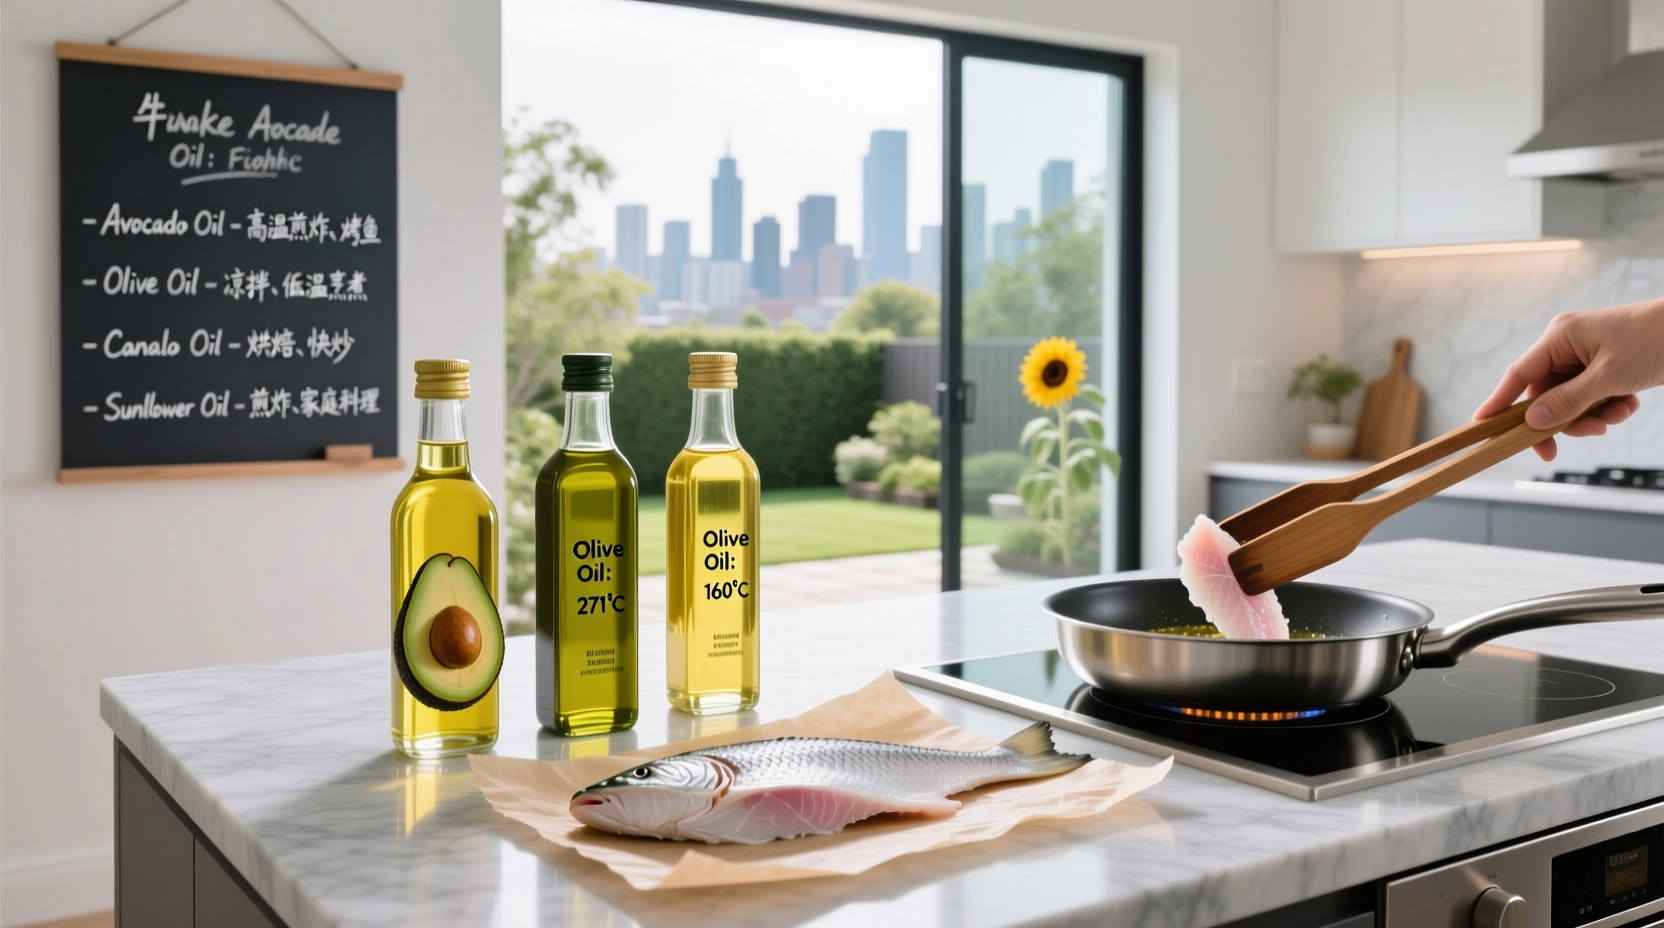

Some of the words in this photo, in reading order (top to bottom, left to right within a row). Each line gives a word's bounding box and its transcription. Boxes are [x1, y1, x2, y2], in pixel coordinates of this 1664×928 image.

[247, 104, 341, 144] Aocade
[169, 142, 214, 168] Oil:
[100, 202, 189, 236] Avocado
[194, 210, 226, 237] Oil
[246, 207, 382, 248] 高温煎炸、烤鱼
[103, 265, 159, 295] Olive
[167, 267, 200, 296] Oil
[103, 328, 181, 359] Canalo
[190, 328, 223, 358] Oil
[245, 326, 356, 365] 烘焙、快炒
[199, 389, 231, 418] Oil
[249, 386, 381, 420] 煎炸、家庭料理
[573, 539, 625, 560] Olive
[703, 529, 750, 548] Olive
[577, 562, 612, 583] Oil:
[704, 551, 735, 571] Oil:
[704, 579, 750, 600] 160°C
